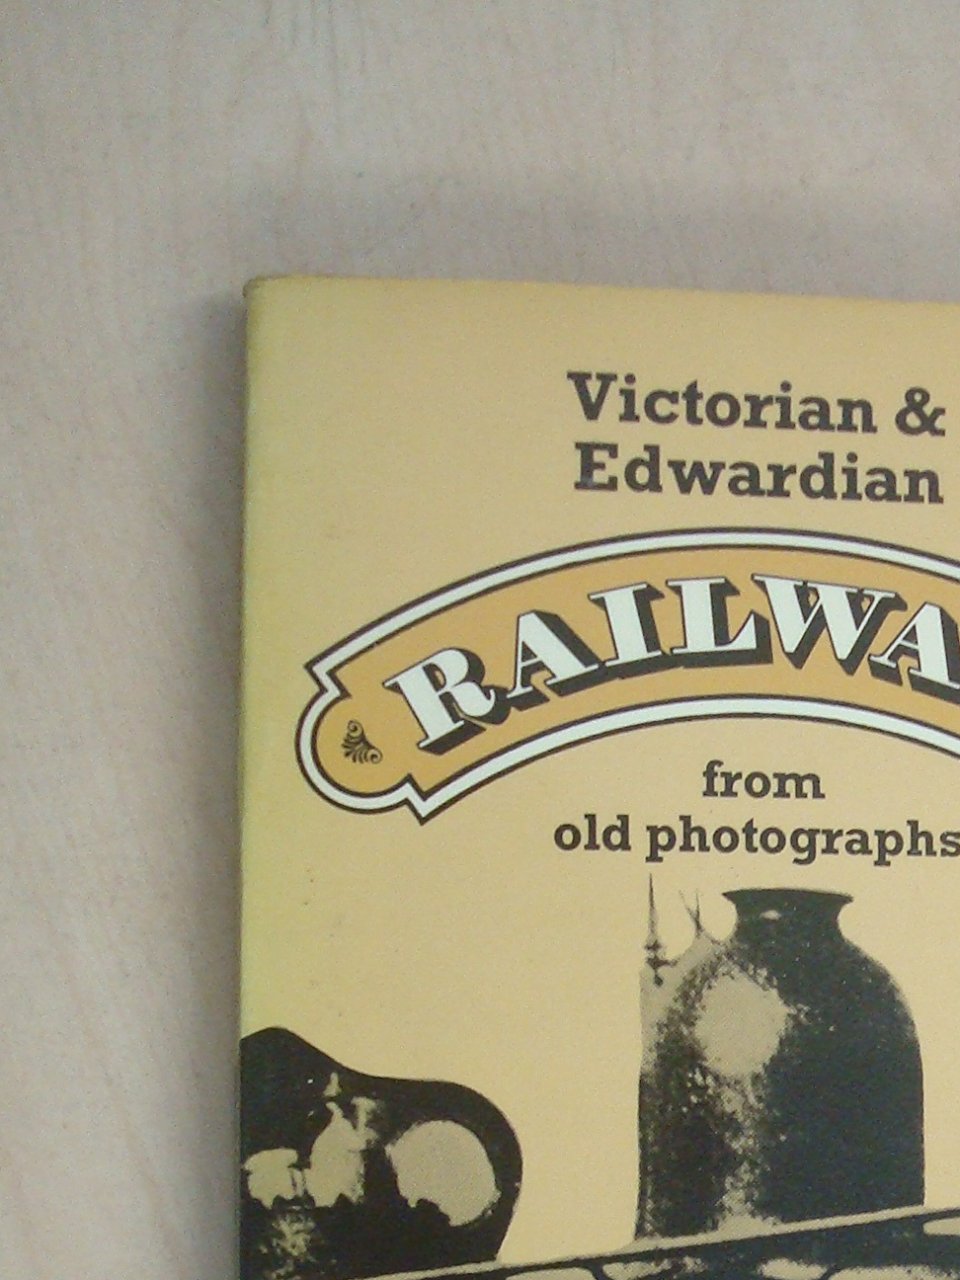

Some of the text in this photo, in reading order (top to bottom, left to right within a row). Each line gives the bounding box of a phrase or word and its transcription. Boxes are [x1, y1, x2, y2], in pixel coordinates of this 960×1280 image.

[568, 371, 947, 437] Victorian &
[573, 442, 944, 505] Edwardian
[701, 759, 826, 800] from
[553, 815, 632, 853] old
